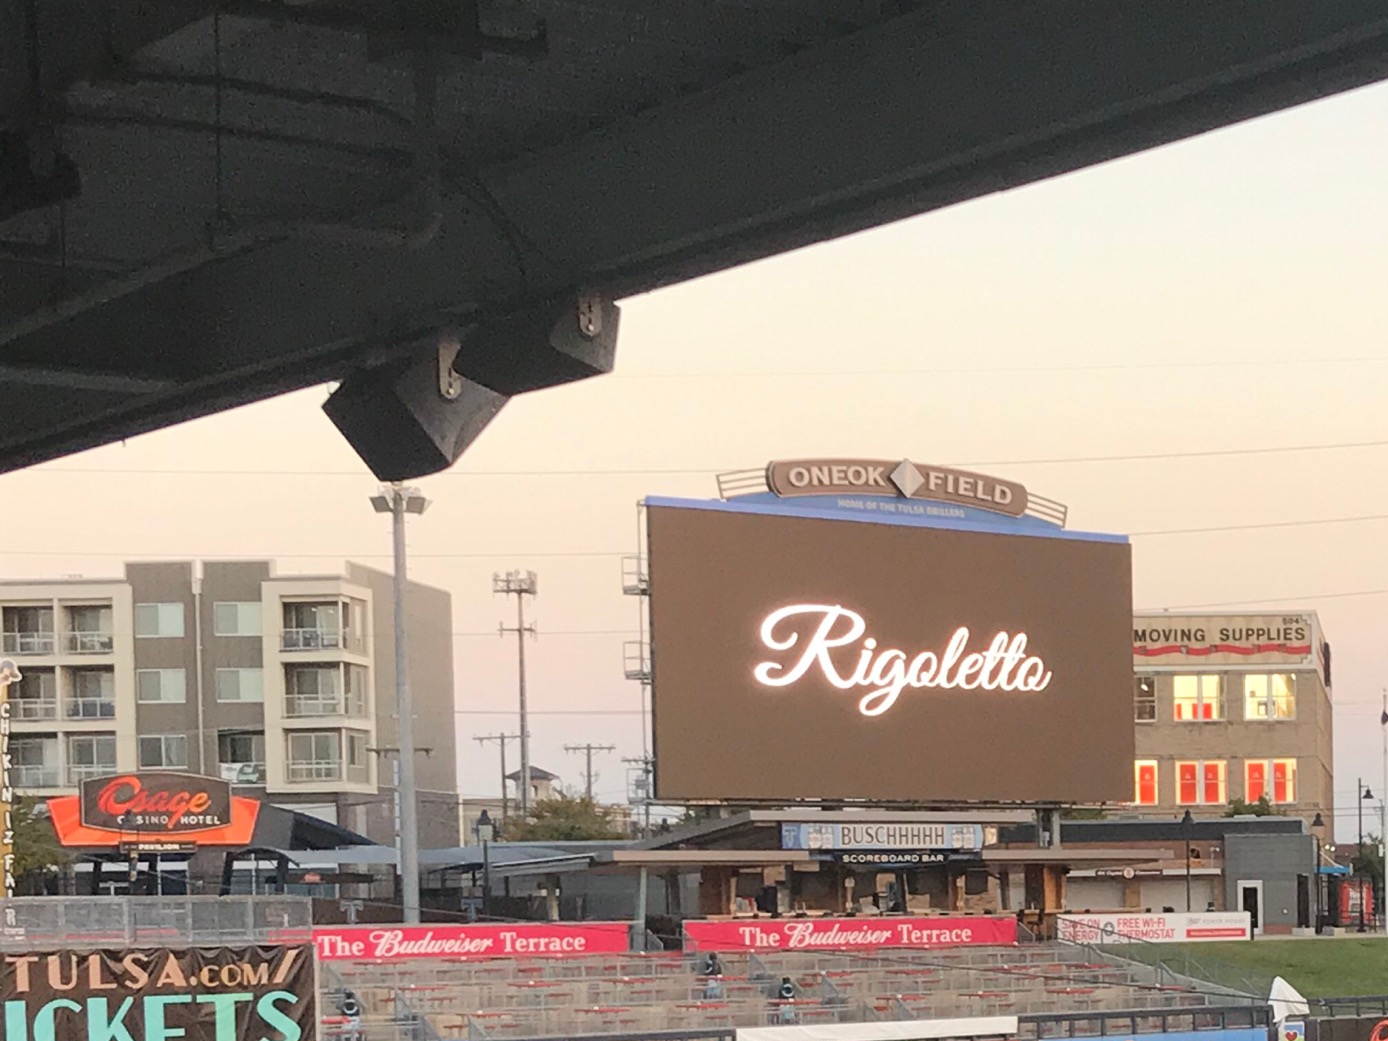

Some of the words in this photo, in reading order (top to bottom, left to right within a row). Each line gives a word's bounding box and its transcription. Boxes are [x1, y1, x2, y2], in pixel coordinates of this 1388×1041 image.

[788, 466, 885, 487] ONEOK
[928, 471, 1012, 504] FIELD
[837, 499, 864, 510] HOME
[866, 501, 877, 510] OF
[879, 503, 896, 512] THE
[898, 504, 925, 514] TULSA
[926, 507, 965, 518] DRILLERS
[1134, 629, 1206, 642] MOVING
[1219, 627, 1306, 642] SUPPLIES
[754, 604, 1052, 716] Rigoletto
[98, 774, 211, 829] Osage
[117, 815, 168, 825] CSINO
[180, 815, 220, 825] HOTEL
[842, 854, 920, 863] SCOREBOARD
[921, 854, 944, 862] BAR
[1062, 918, 1086, 929] SAVE
[1087, 918, 1100, 929] ON
[1117, 918, 1140, 928] FREE
[1142, 917, 1166, 927] WI-FI
[739, 927, 780, 947] The
[784, 922, 892, 948] Budweiser
[898, 924, 972, 944] Terrace
[1062, 929, 1099, 940] ENERGY
[1118, 929, 1175, 939] THERMOSTAT
[318, 935, 364, 957] The
[369, 930, 494, 957] Budweiser
[500, 931, 586, 953] Terrace
